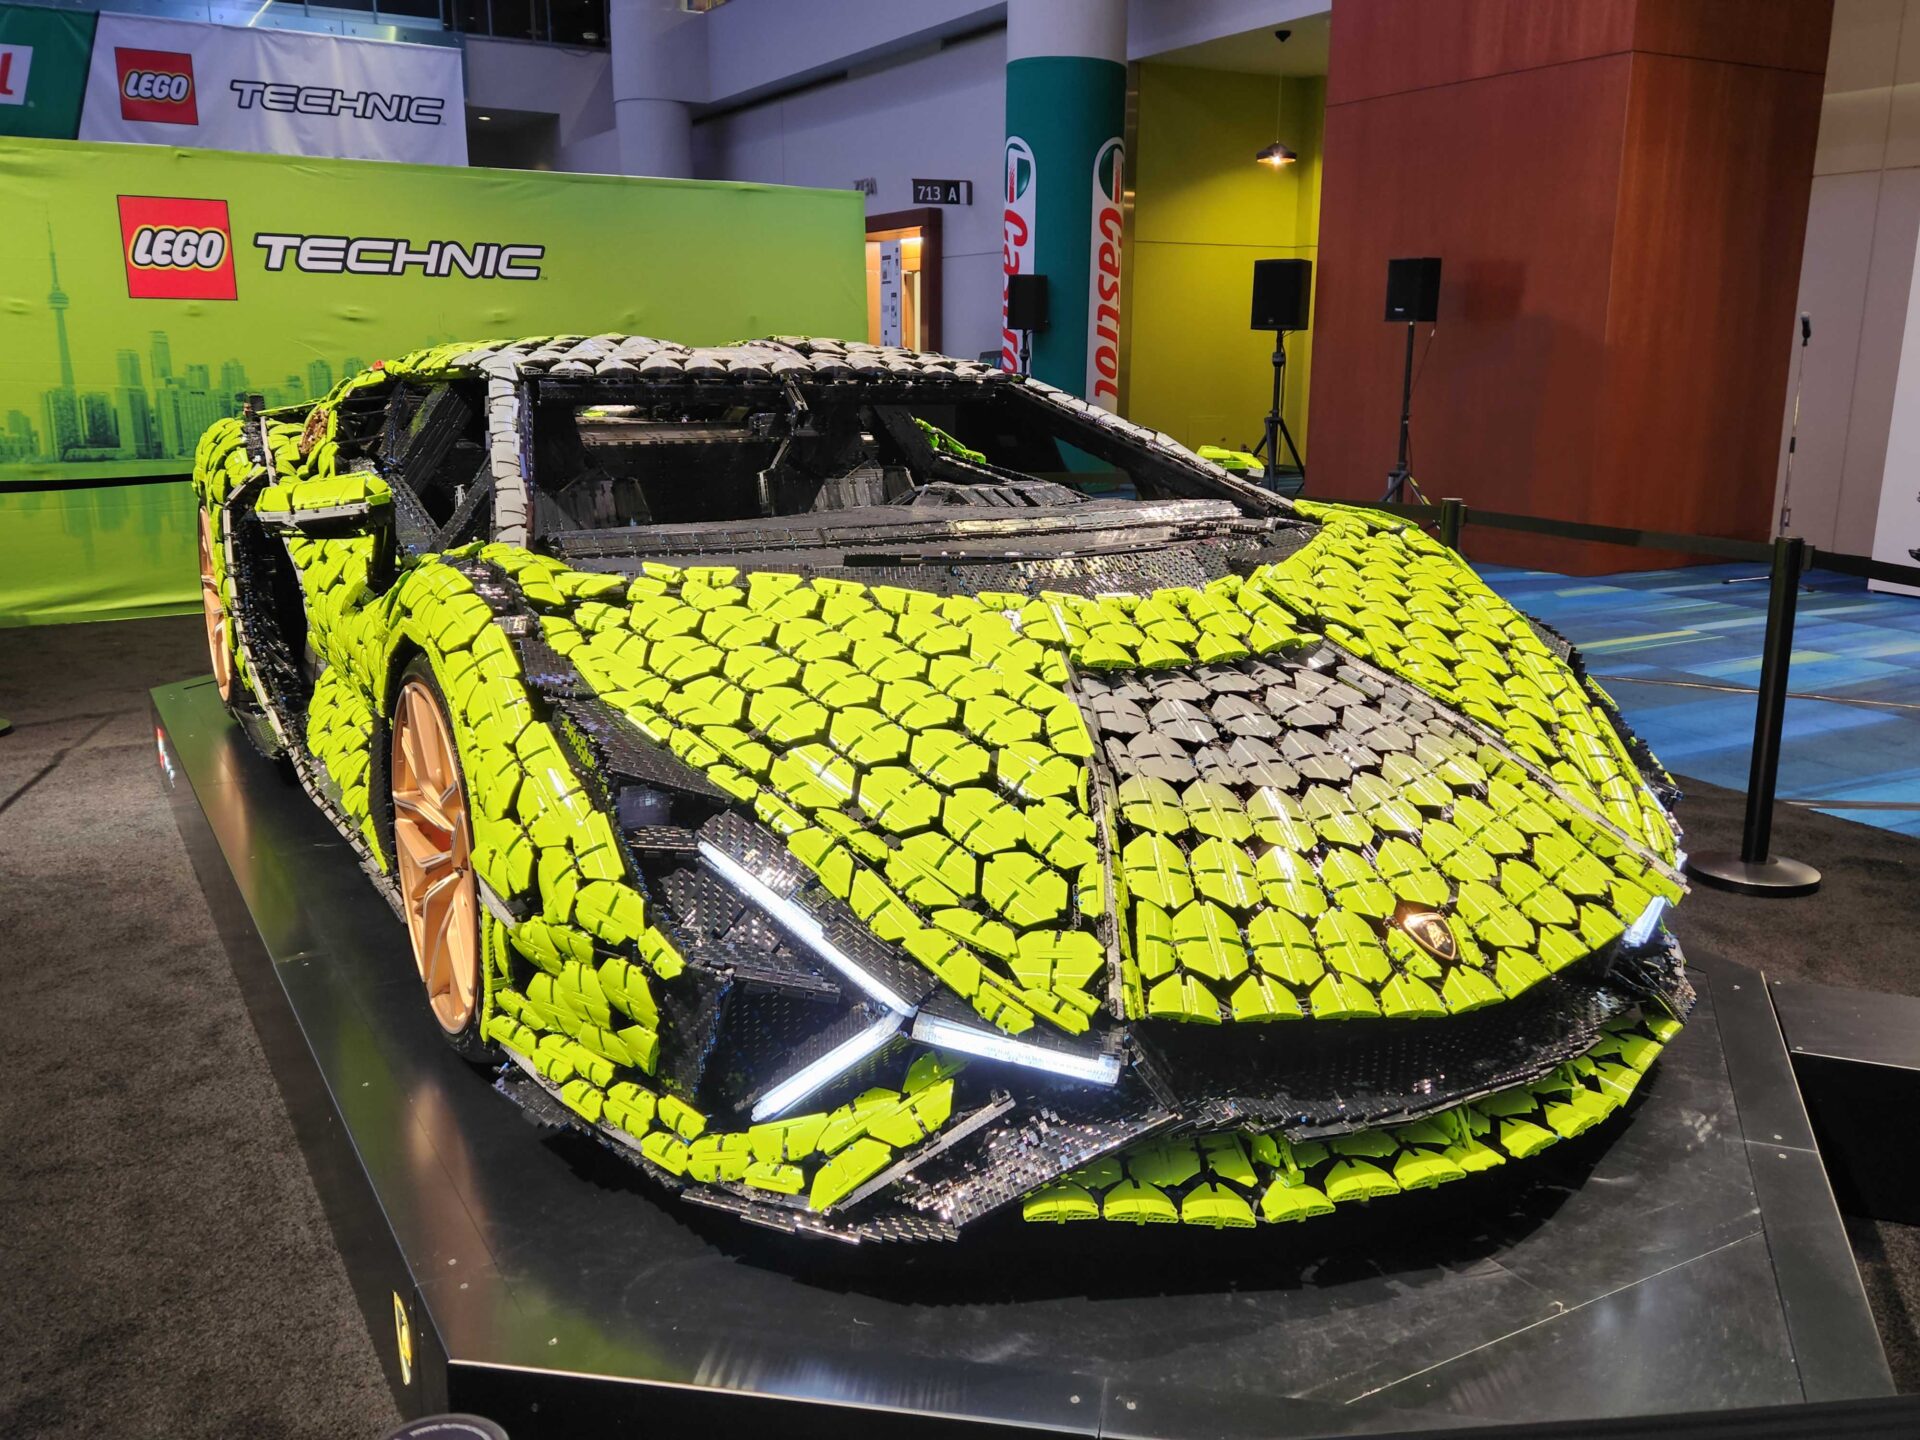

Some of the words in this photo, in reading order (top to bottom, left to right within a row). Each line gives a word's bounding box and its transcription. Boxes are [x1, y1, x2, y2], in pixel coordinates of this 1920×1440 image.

[124, 71, 191, 102] LEGO
[231, 80, 444, 125] TECHNIC
[917, 185, 941, 201] 713
[948, 186, 957, 201] A
[132, 227, 227, 270] LEGO
[254, 232, 545, 280] TECHNIC
[1095, 207, 1123, 397] Castrol
